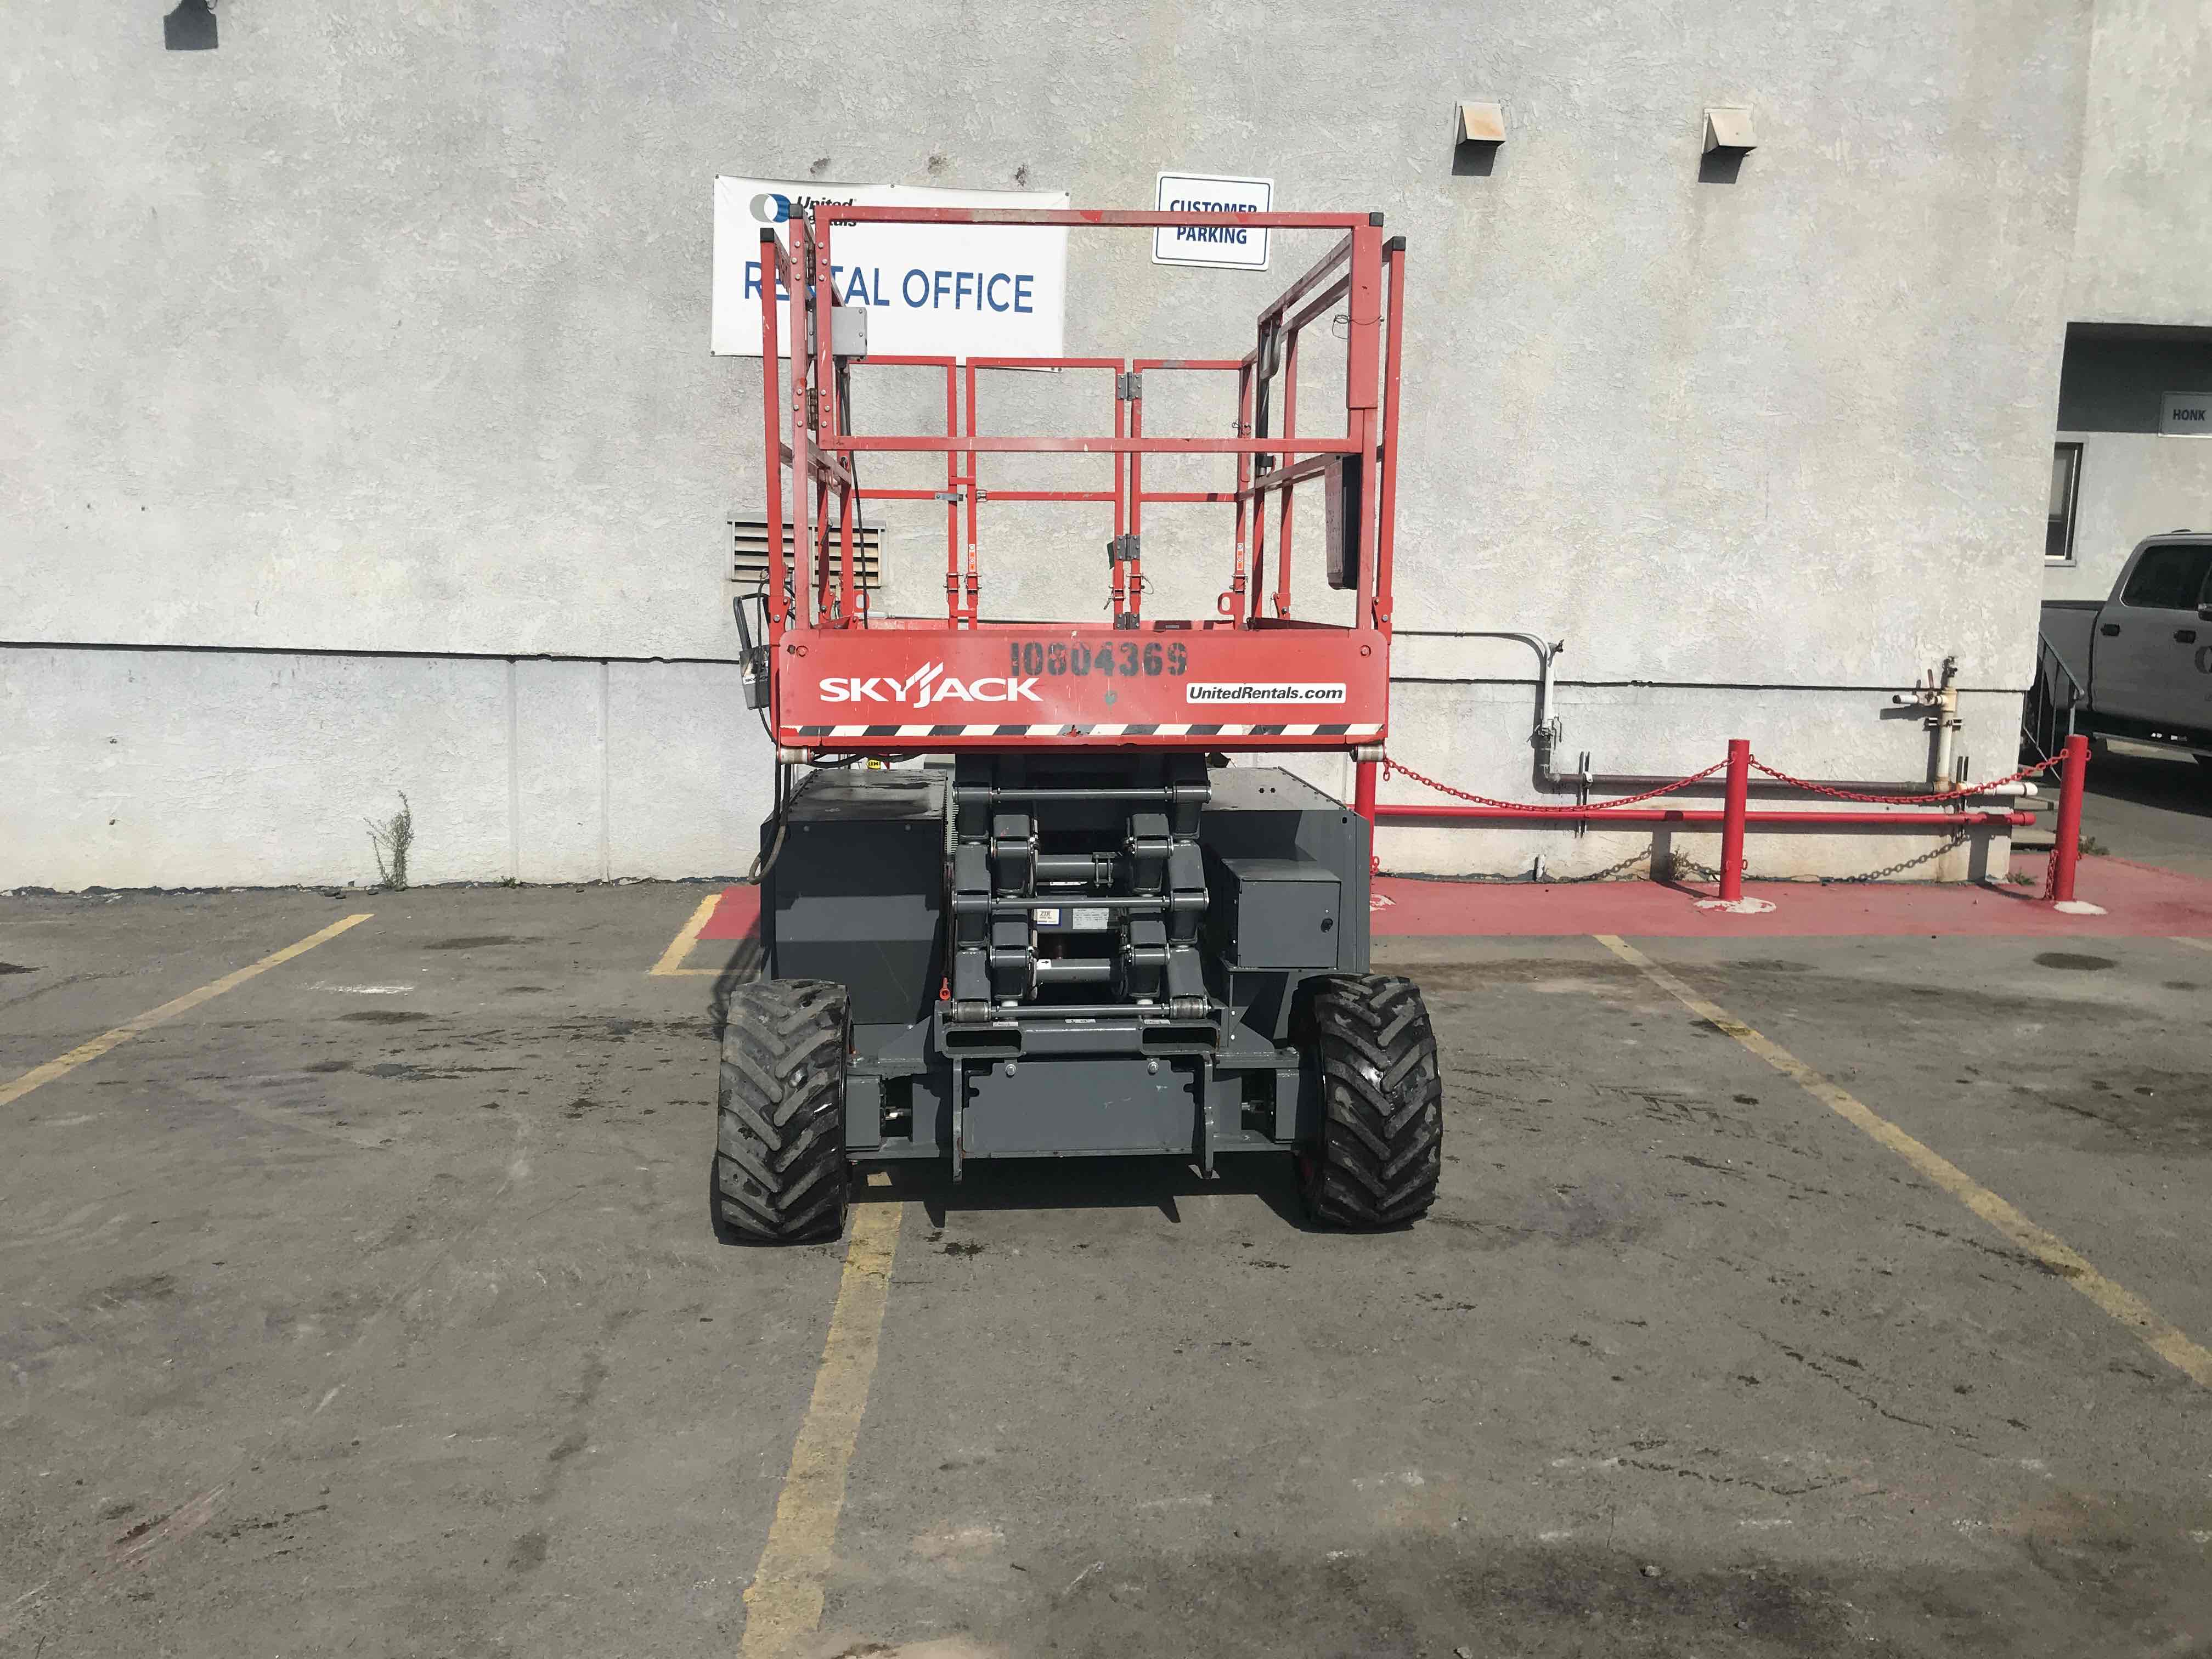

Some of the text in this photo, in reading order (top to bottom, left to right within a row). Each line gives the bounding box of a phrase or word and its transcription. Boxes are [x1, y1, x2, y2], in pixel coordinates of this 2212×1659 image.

[1177, 226, 1247, 245] PARKING
[744, 261, 1034, 313] RAL OFFICE
[2172, 409, 2207, 421] HONK
[1011, 641, 1187, 676] 10804369
[819, 661, 1043, 708] SKYJACK
[1189, 687, 1343, 699] UnitedRentals.com
